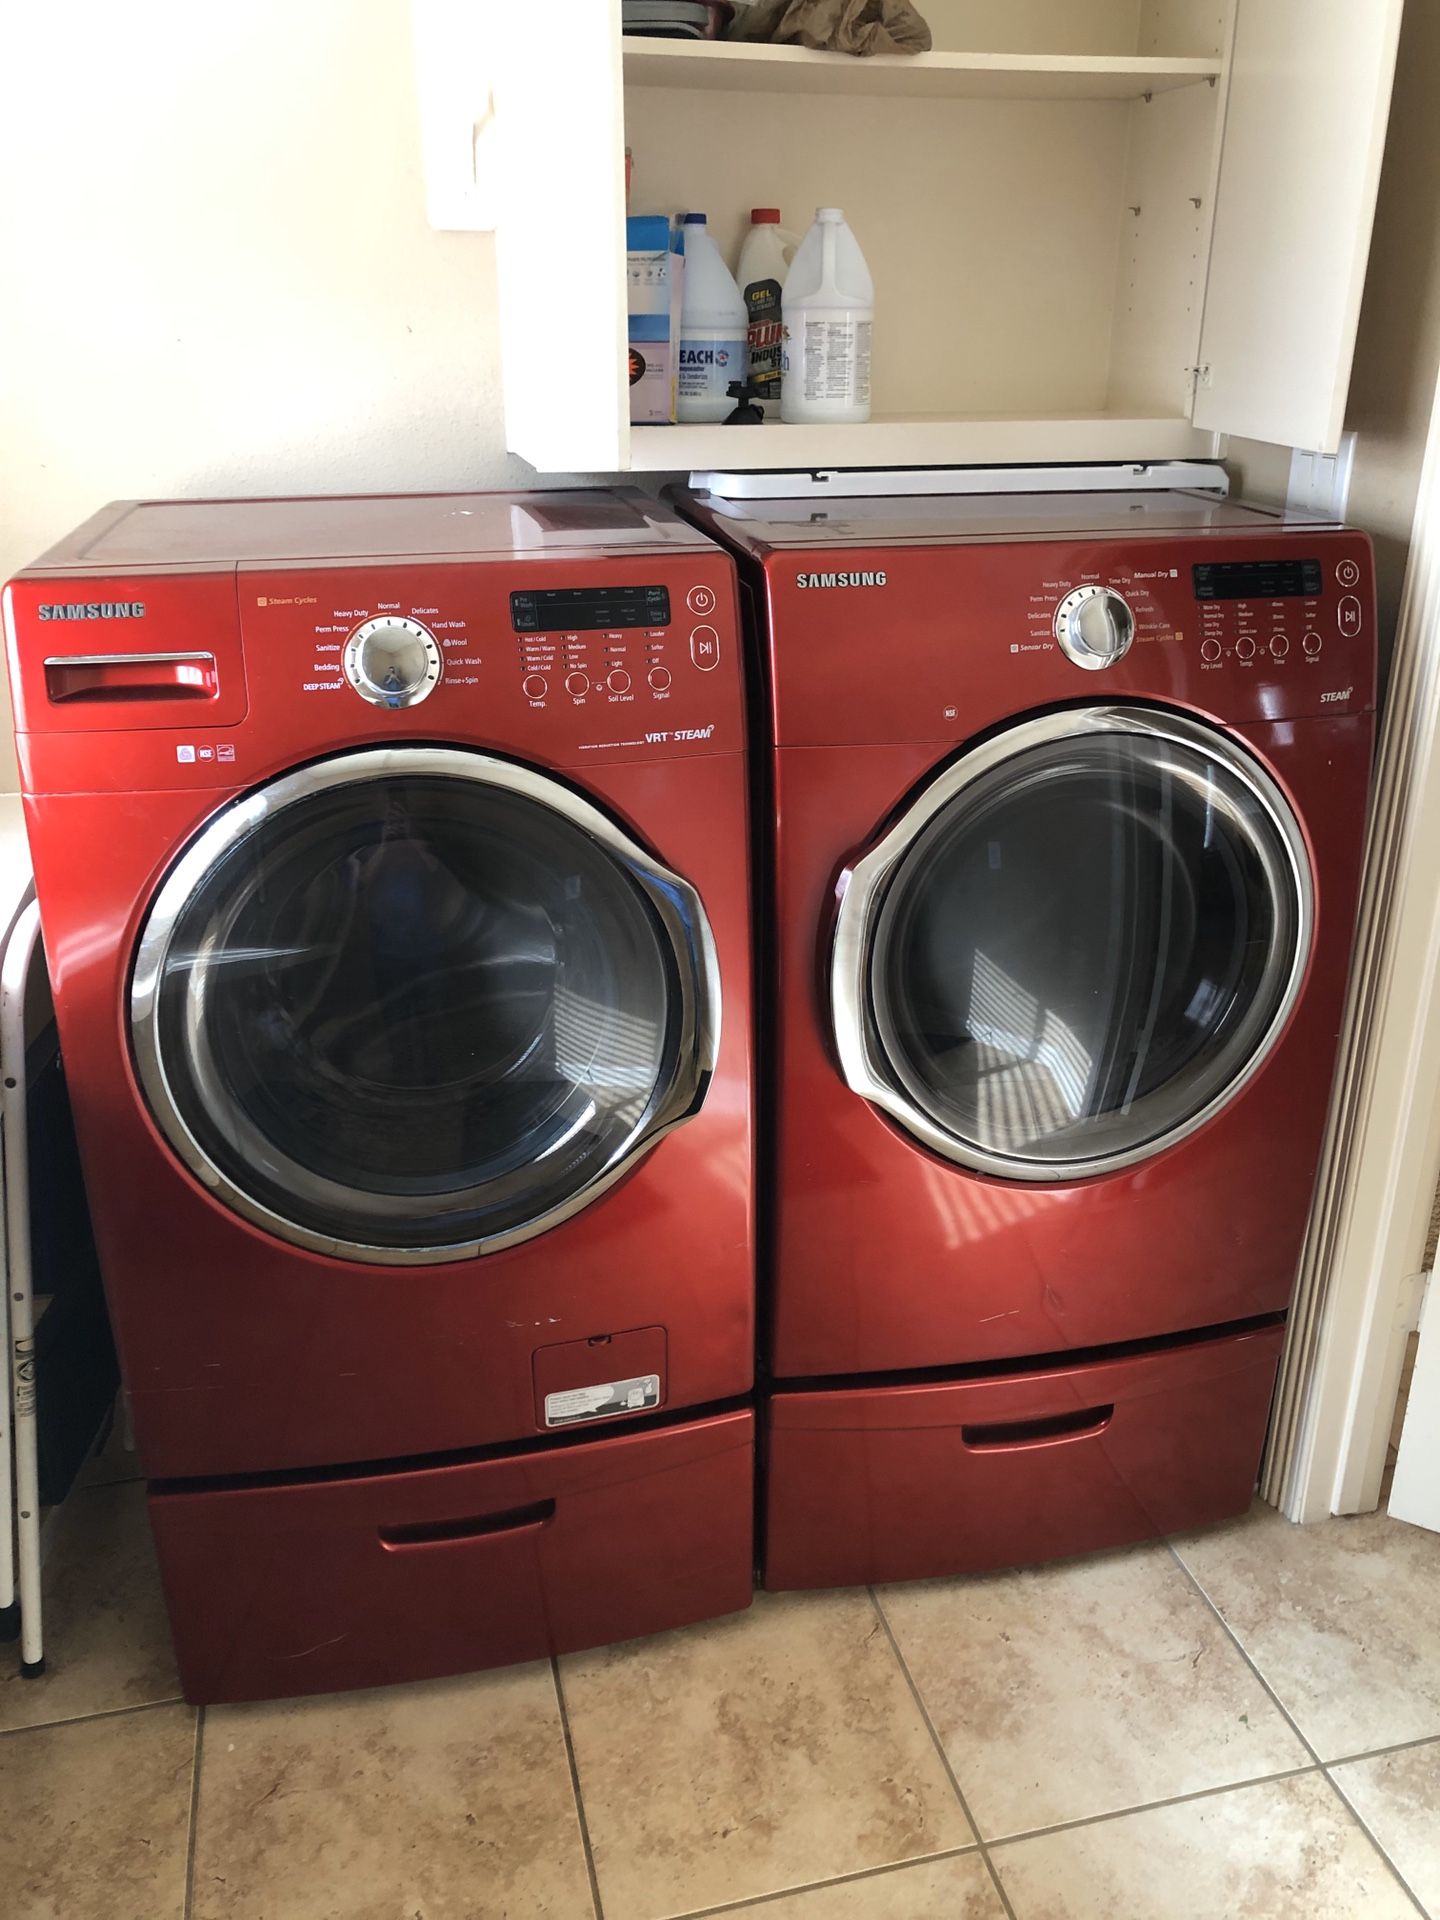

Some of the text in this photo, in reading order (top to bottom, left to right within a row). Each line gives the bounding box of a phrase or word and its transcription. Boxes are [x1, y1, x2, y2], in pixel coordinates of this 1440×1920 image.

[752, 290, 771, 300] GEL
[679, 350, 713, 364] EACH
[751, 346, 781, 364] INDUS
[797, 571, 887, 588] SAMSUNG
[1121, 577, 1131, 585] Dry
[269, 596, 317, 605] Steam Cycles
[38, 602, 145, 621] SAMSUNG
[334, 609, 368, 618] Heavy Duty
[411, 607, 439, 615] Delicates
[333, 625, 349, 633] Press
[1043, 643, 1054, 651] Dry
[314, 664, 340, 672] Bedding
[620, 694, 634, 702] Level
[653, 692, 670, 700] Signal
[1320, 690, 1352, 702] STEAM
[573, 697, 586, 705] Spin
[674, 728, 711, 741] STEAM
